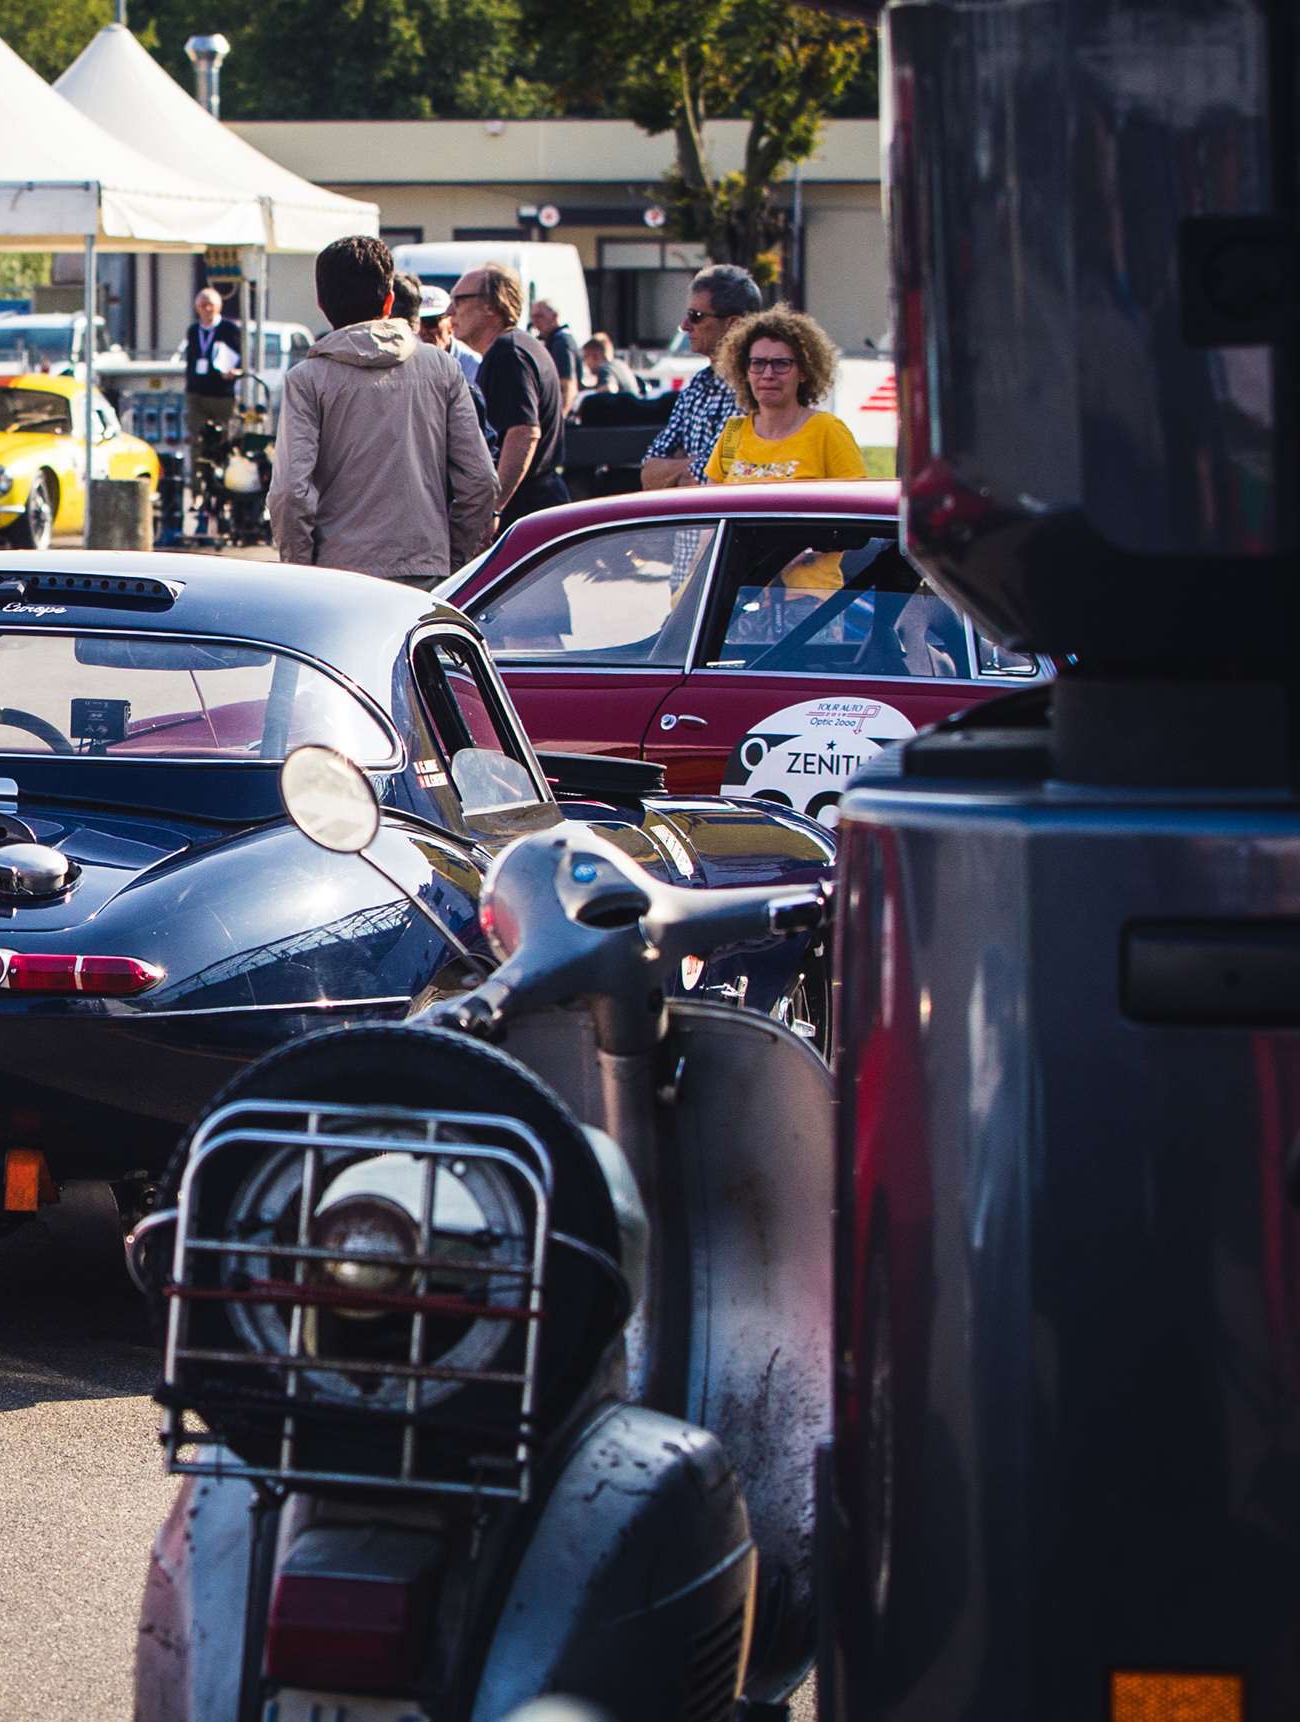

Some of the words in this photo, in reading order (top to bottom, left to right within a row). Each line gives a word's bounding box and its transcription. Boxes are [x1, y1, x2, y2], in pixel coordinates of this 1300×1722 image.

[2, 602, 68, 617] Europe
[817, 703, 840, 711] TOUR
[841, 703, 864, 712] AUTO
[810, 717, 833, 727] Optic
